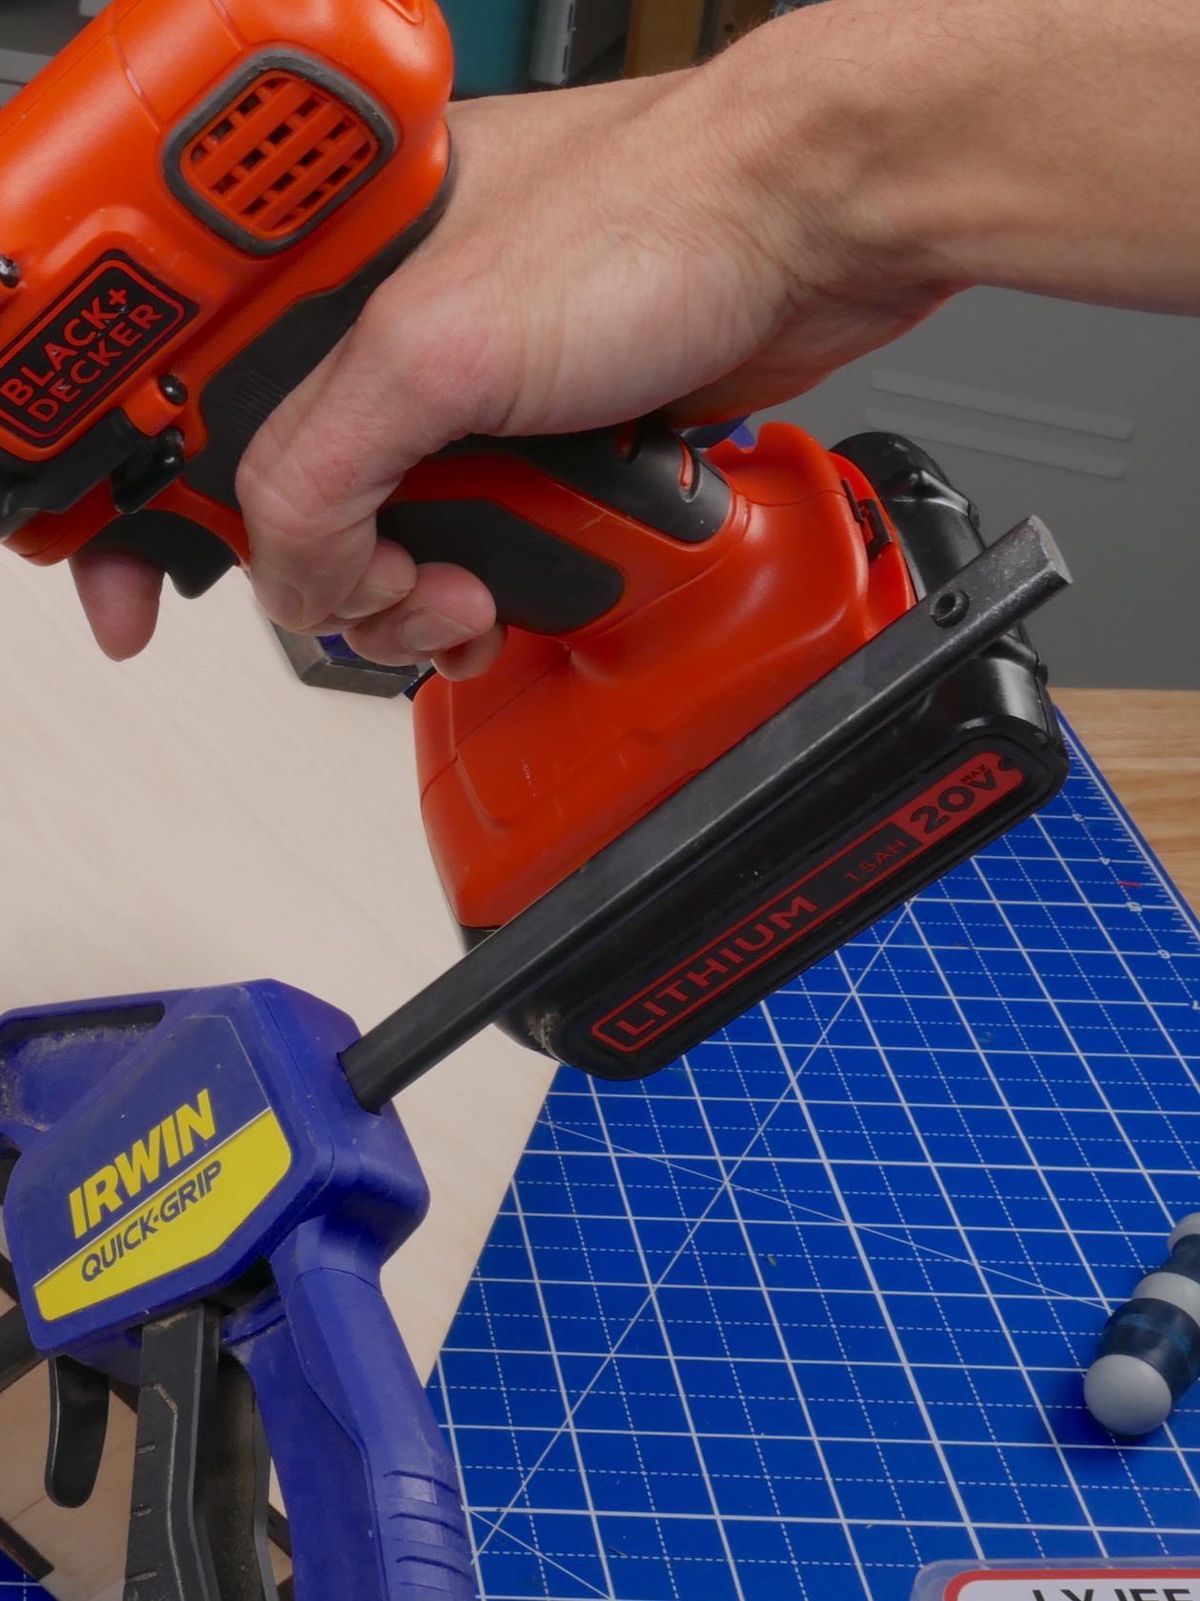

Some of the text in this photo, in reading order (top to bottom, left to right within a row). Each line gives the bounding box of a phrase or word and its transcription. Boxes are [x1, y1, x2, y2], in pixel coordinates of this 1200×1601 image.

[27, 303, 164, 423] DECKER
[910, 768, 997, 834] 20V
[616, 895, 818, 1036] LITHIUM
[69, 1087, 216, 1240] IRWIN
[81, 1159, 222, 1283] QUICK-GRIP
